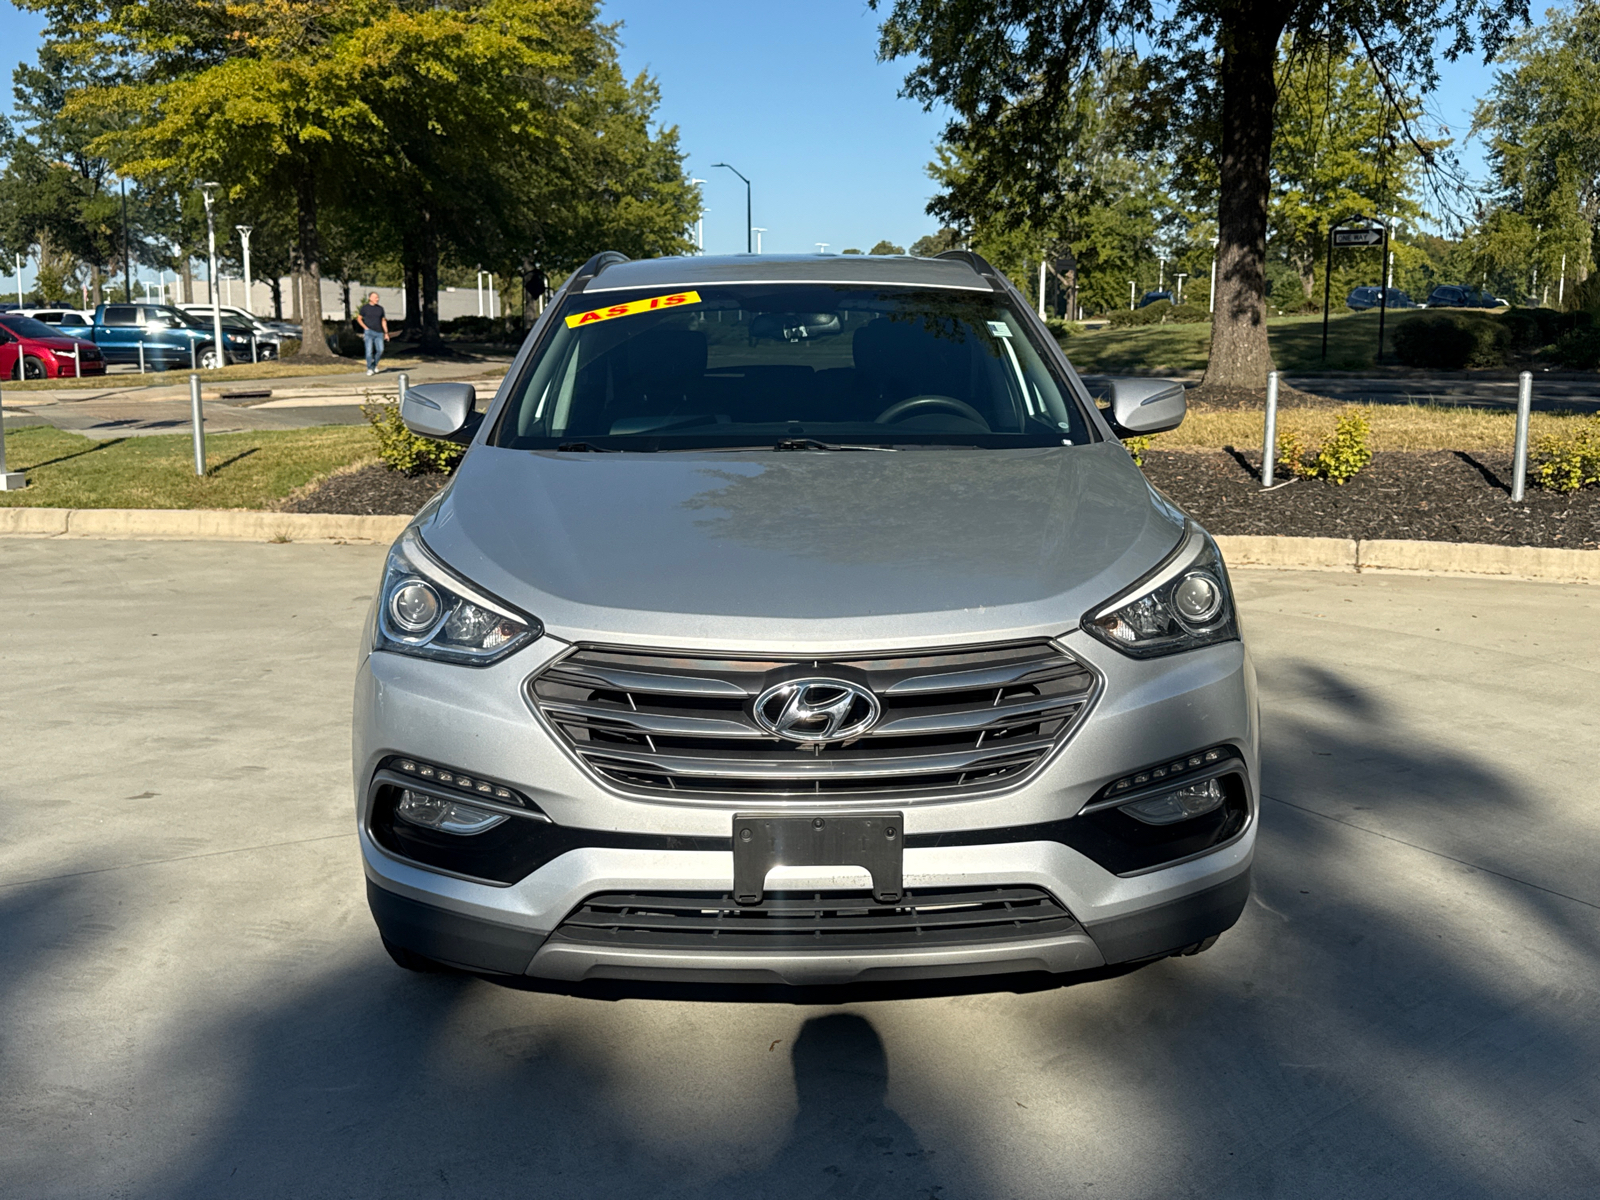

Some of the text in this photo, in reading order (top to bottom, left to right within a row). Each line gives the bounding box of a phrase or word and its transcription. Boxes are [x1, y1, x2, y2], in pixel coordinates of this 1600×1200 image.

[1337, 234, 1351, 242] ONE
[578, 294, 688, 325] AS IS
